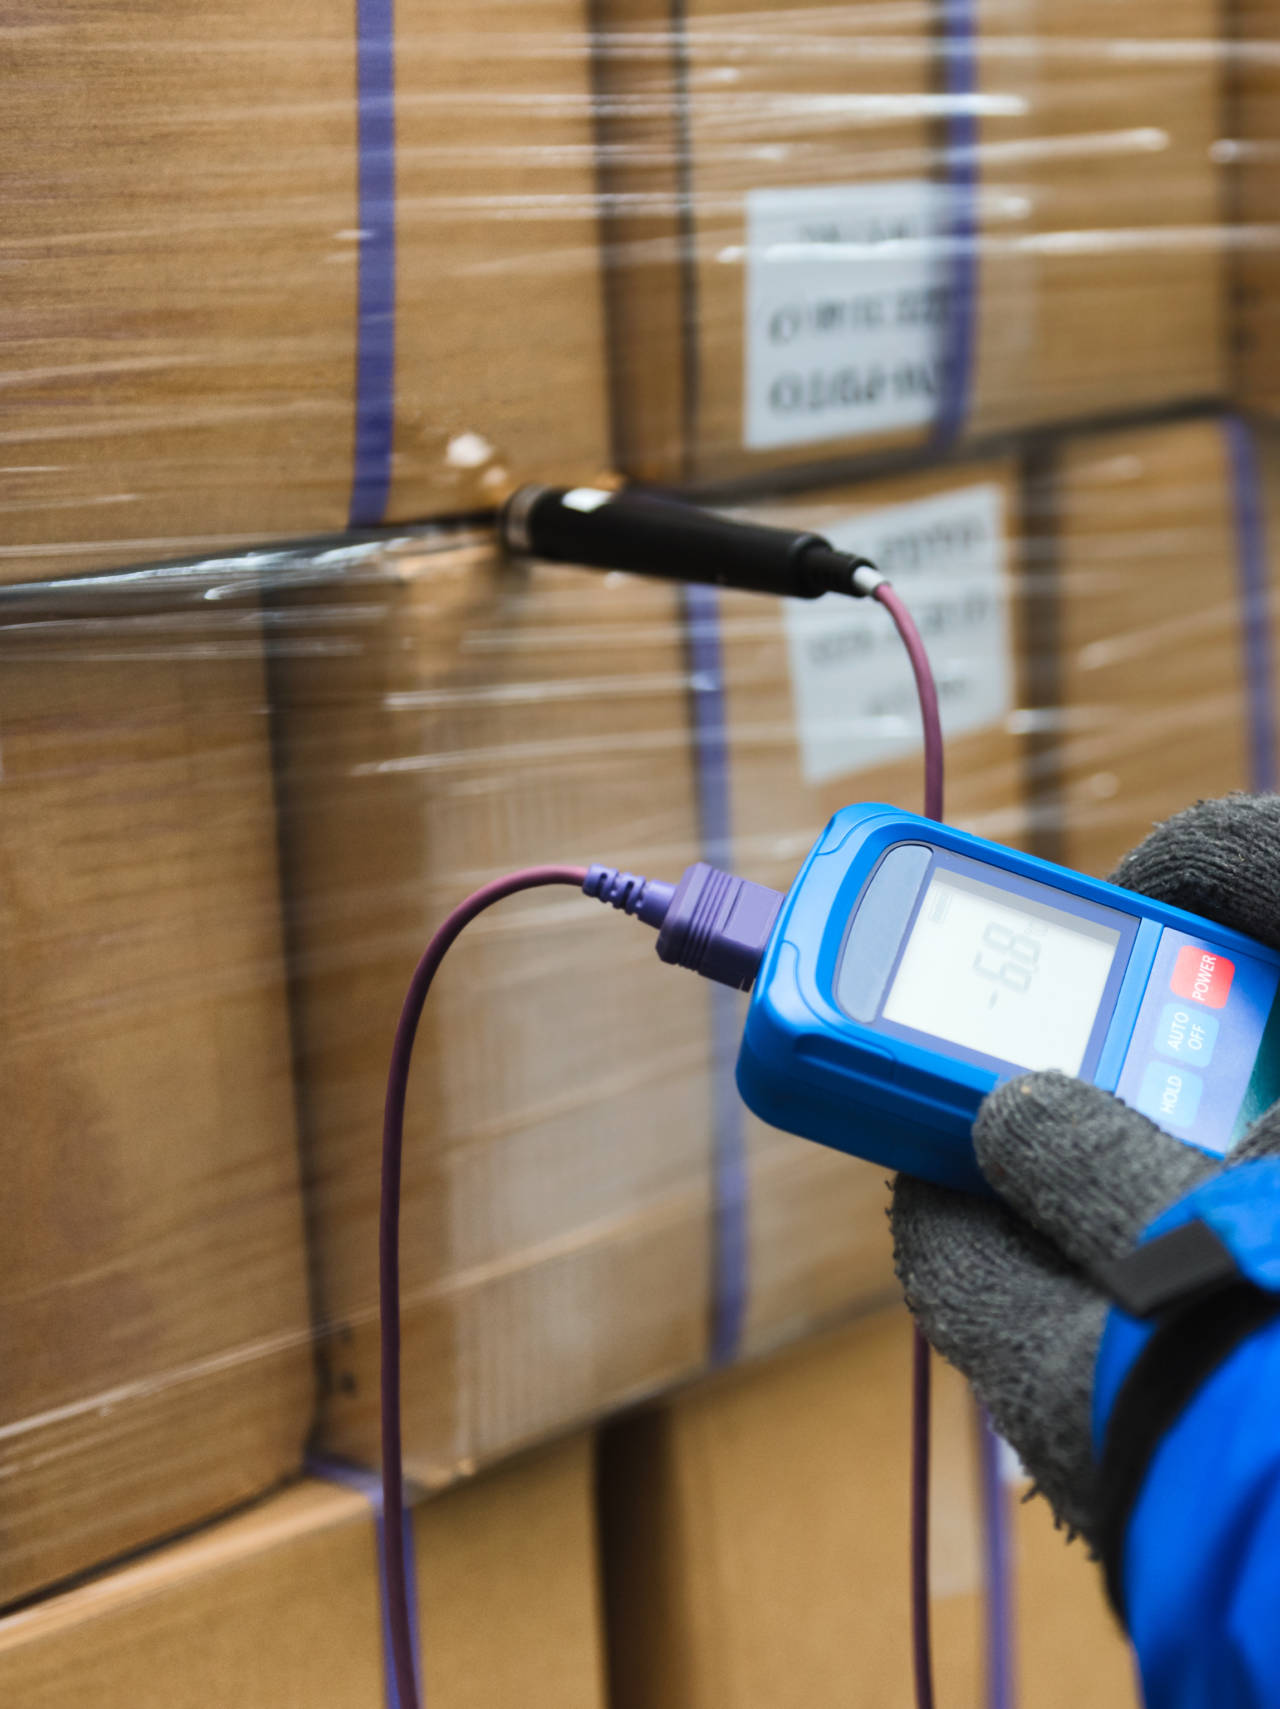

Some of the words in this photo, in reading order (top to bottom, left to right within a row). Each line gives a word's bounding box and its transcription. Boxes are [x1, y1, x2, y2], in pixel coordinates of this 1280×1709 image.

[1192, 953, 1217, 1001] POWER
[1167, 1011, 1190, 1051] AUTO
[1187, 1023, 1206, 1051] OFF
[1160, 1074, 1183, 1114] HOLD
